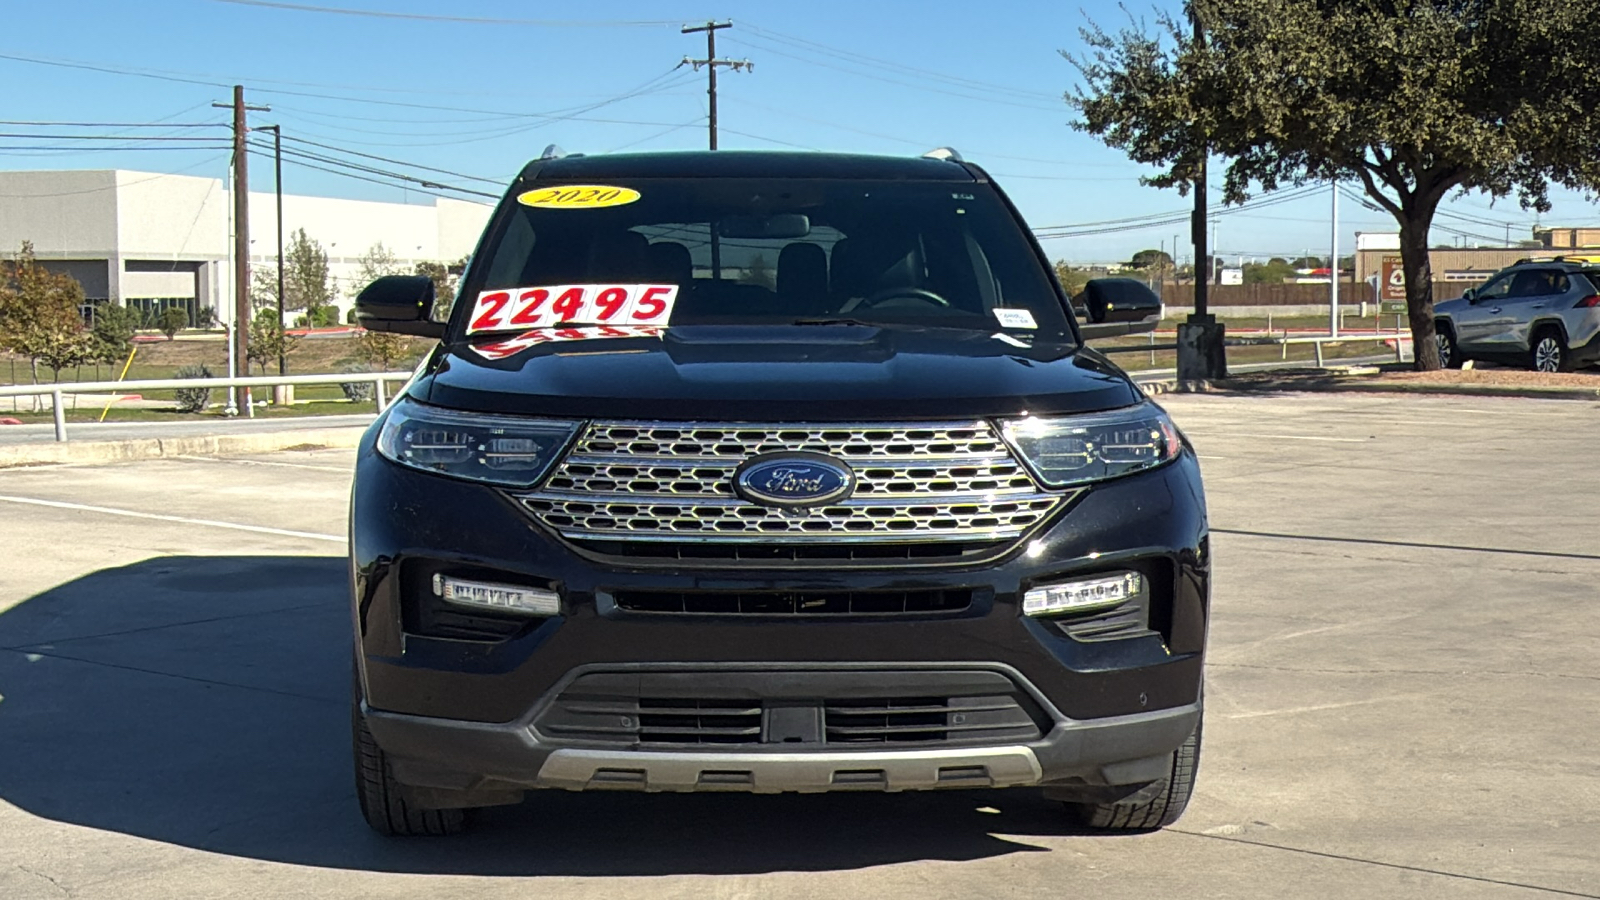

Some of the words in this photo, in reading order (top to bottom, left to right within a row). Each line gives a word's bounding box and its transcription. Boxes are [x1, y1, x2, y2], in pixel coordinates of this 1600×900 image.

[536, 189, 622, 204] 2020
[471, 287, 673, 330] 22495
[765, 468, 825, 492] Ford
